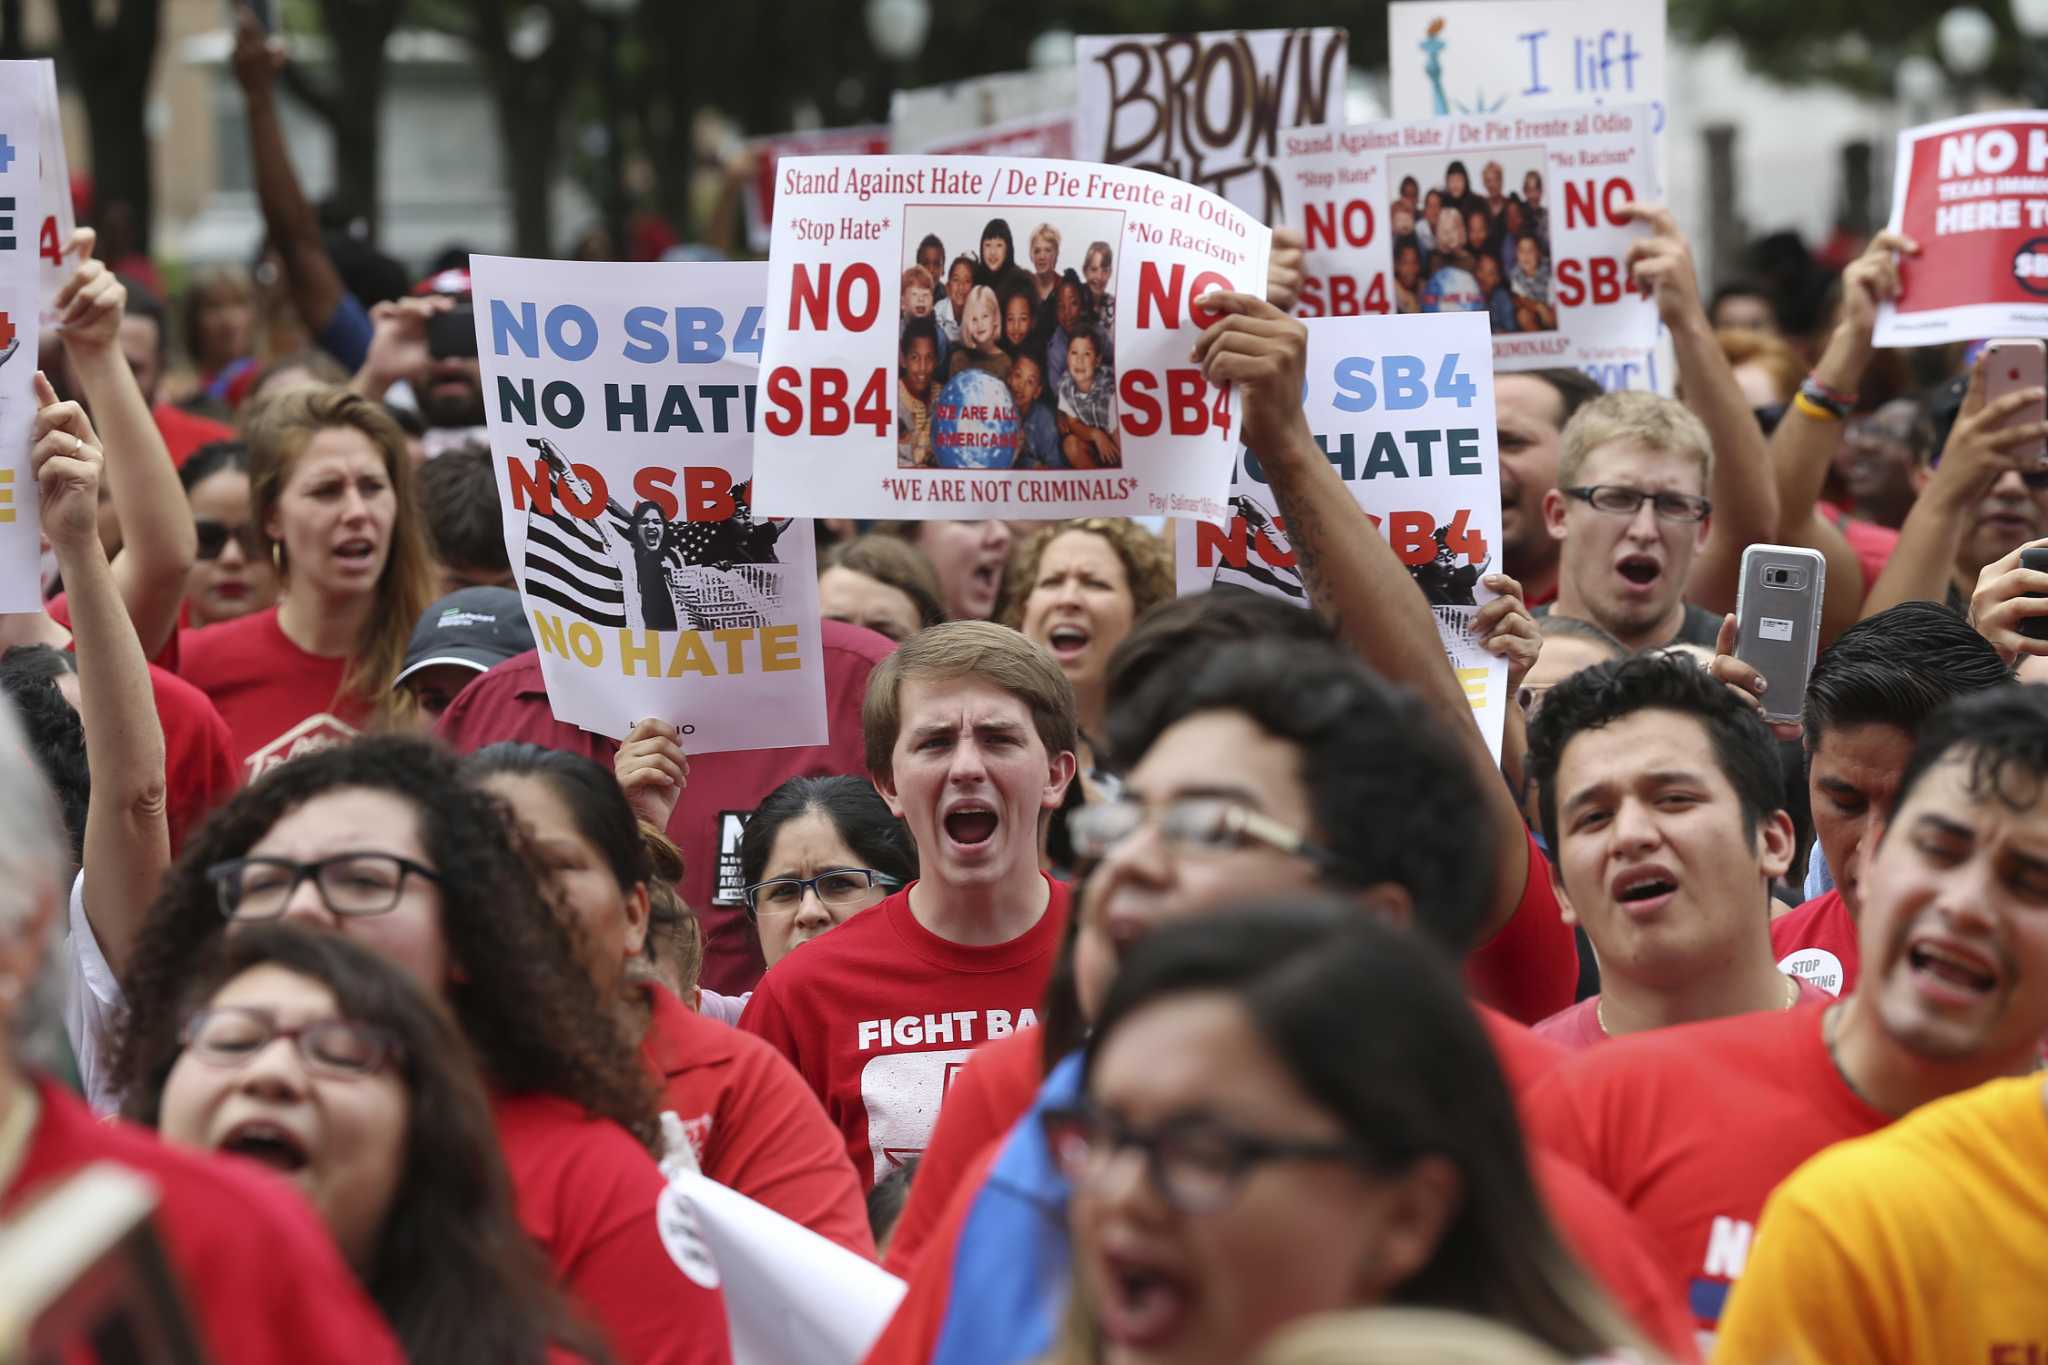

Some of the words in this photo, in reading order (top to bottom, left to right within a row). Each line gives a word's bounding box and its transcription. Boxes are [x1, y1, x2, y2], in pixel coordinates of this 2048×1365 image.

[1574, 29, 1642, 91] lift
[1092, 29, 1346, 164] BROWN
[1286, 133, 1333, 156] Stand
[1339, 131, 1400, 155] Against
[1403, 126, 1442, 146] Hate
[1459, 121, 1482, 143] De
[1485, 120, 1511, 142] Pie
[1515, 118, 1569, 139] Frente
[1573, 114, 1589, 135] al
[1593, 112, 1633, 134] Odio
[1938, 129, 2019, 179] NO
[785, 167, 839, 197] Stand
[844, 168, 926, 201] Against
[930, 168, 982, 196] Hate
[1007, 168, 1038, 197] De
[1044, 171, 1081, 198] Pie
[1086, 173, 1165, 207] Frente
[1171, 186, 1193, 214] al
[1198, 199, 1247, 239] Odio
[1303, 199, 1375, 251] NO
[1563, 177, 1635, 229] NO
[1936, 200, 2021, 236] HERE
[787, 262, 882, 333] NO
[1136, 261, 1236, 331] NO
[1296, 271, 1391, 318] SB4
[490, 299, 599, 362] NO
[622, 305, 765, 364] SB4
[497, 376, 586, 429] NO
[765, 365, 892, 437] SB4
[1119, 368, 1232, 442] SB4
[1332, 353, 1477, 413] SB4
[961, 405, 989, 420] ARE
[992, 404, 1020, 420] ALL
[935, 431, 1019, 449] AMERICANS
[1313, 428, 1484, 481] HATE
[506, 455, 609, 521] NO
[633, 466, 754, 523] SB
[925, 479, 965, 502] ARE
[970, 478, 1012, 502] NOT
[534, 609, 604, 669] NO
[620, 624, 801, 678] HATE
[1791, 959, 1821, 975] STOP
[858, 1010, 978, 1050] FIGHT
